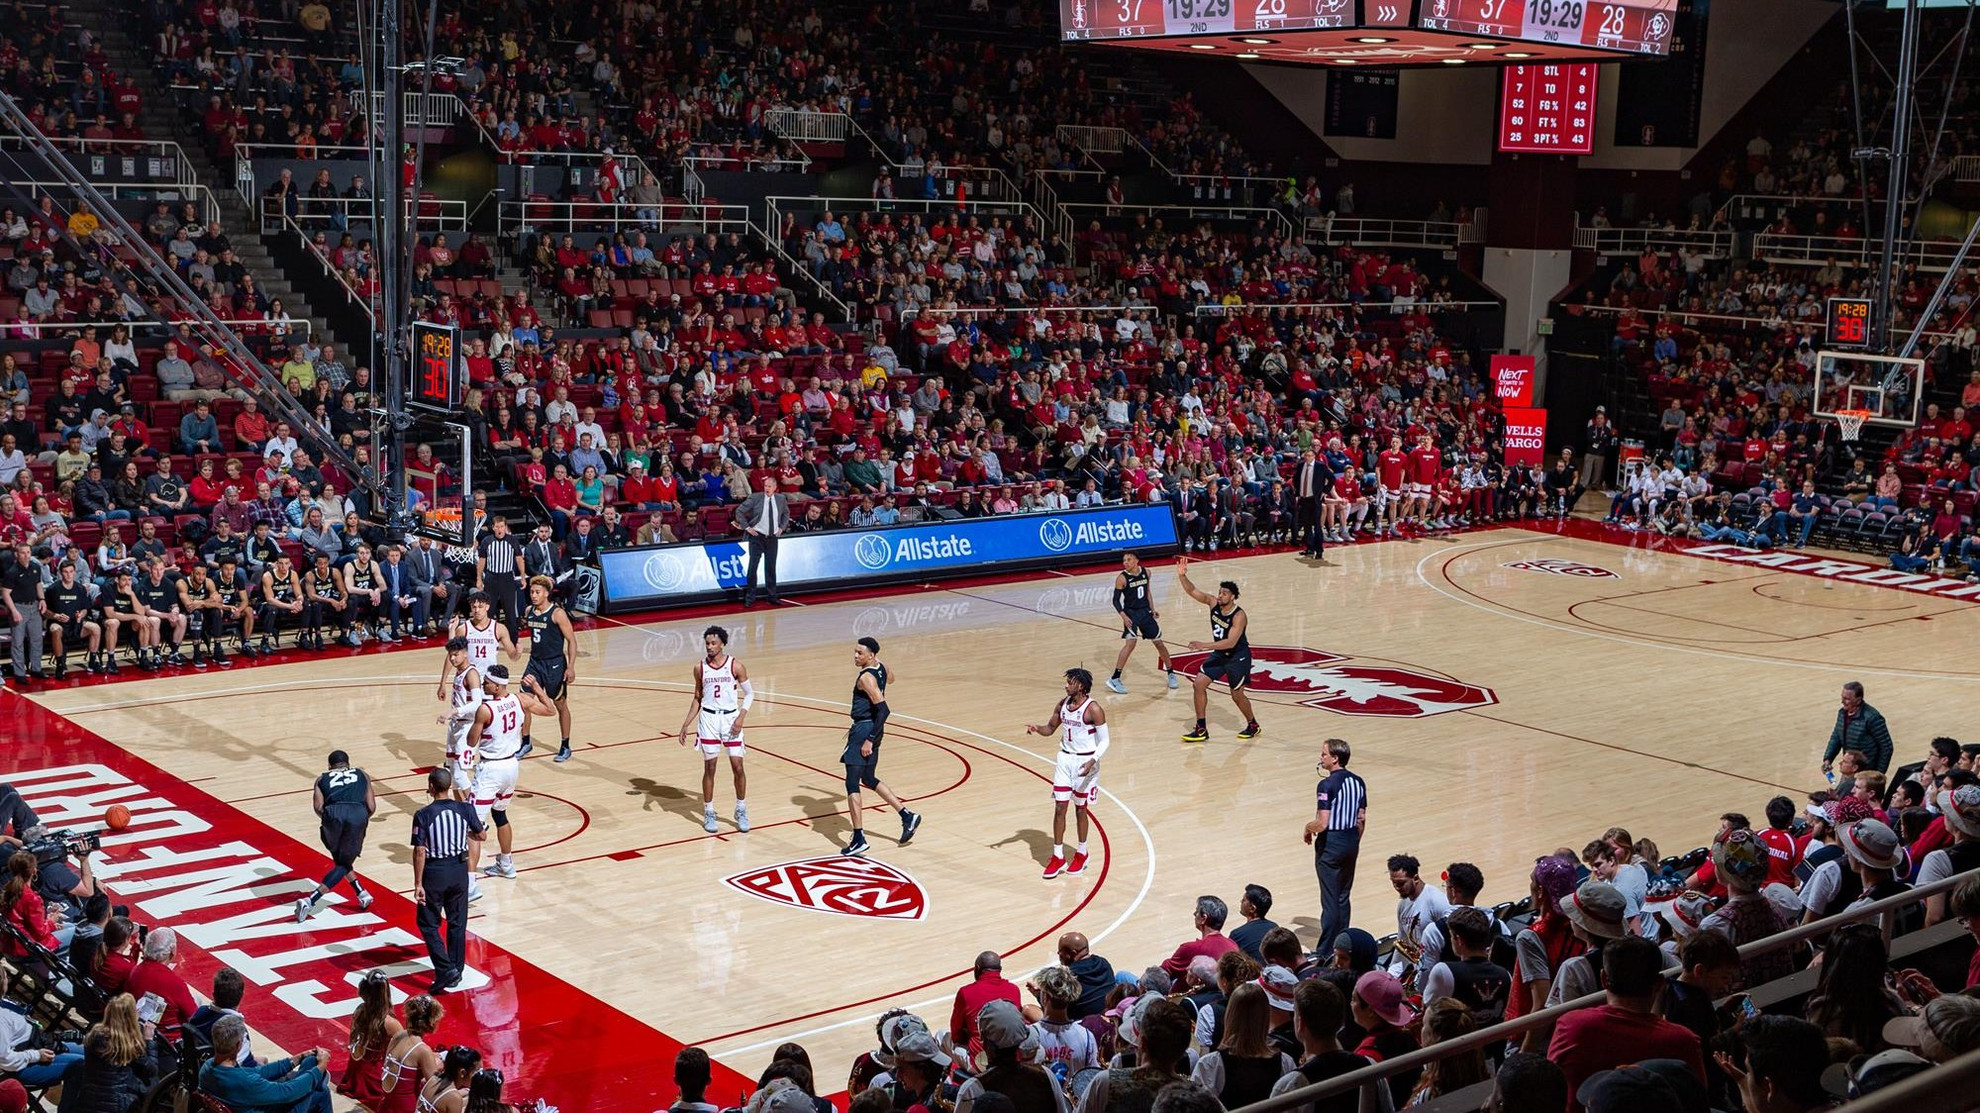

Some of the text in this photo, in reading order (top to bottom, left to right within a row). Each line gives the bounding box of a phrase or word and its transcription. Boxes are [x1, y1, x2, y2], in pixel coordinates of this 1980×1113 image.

[1117, 0, 1142, 22] 37
[1168, 0, 1230, 19] 19:29
[1480, 0, 1505, 19] 37
[1530, 0, 1582, 29] 19:29
[1190, 22, 1207, 32] 2ND
[1255, 21, 1270, 29] FLS
[1313, 15, 1342, 27] TOL 2
[1423, 19, 1448, 31] TOL 4
[1600, 5, 1625, 35] 28
[1066, 29, 1090, 40] TOL 4
[1119, 27, 1145, 37] FLS 0
[1477, 24, 1503, 35] FLS 0
[1543, 30, 1559, 41] 2ND
[1597, 37, 1609, 48] FLS
[1640, 43, 1651, 53] TOL
[1655, 43, 1661, 54] 2
[1517, 66, 1587, 77] 3 STL 4
[1516, 83, 1586, 94] 7 TO 8
[1512, 99, 1587, 111] 52 FG % 42
[1511, 116, 1585, 128] 60 FT % 83
[1510, 132, 1584, 144] 25 3PT % 43
[1838, 303, 1867, 317] 19:28
[1837, 316, 1862, 340] 30
[424, 334, 451, 357] 19:28
[424, 358, 447, 399] 30
[1498, 368, 1528, 381] NEXT
[1497, 385, 1521, 398] NOW
[1075, 518, 1143, 545] Allstate
[894, 534, 972, 562] Allstate
[690, 554, 748, 582] Allst
[1137, 585, 1144, 600] 0
[533, 628, 541, 643] 5
[1213, 624, 1224, 639] 21
[475, 645, 487, 658] 14
[704, 676, 731, 684] STANFORD
[714, 684, 721, 698] 2
[502, 711, 517, 734] 13
[1067, 728, 1072, 742] 1
[329, 769, 358, 788] 25
[0, 763, 490, 1019] STANFORD
